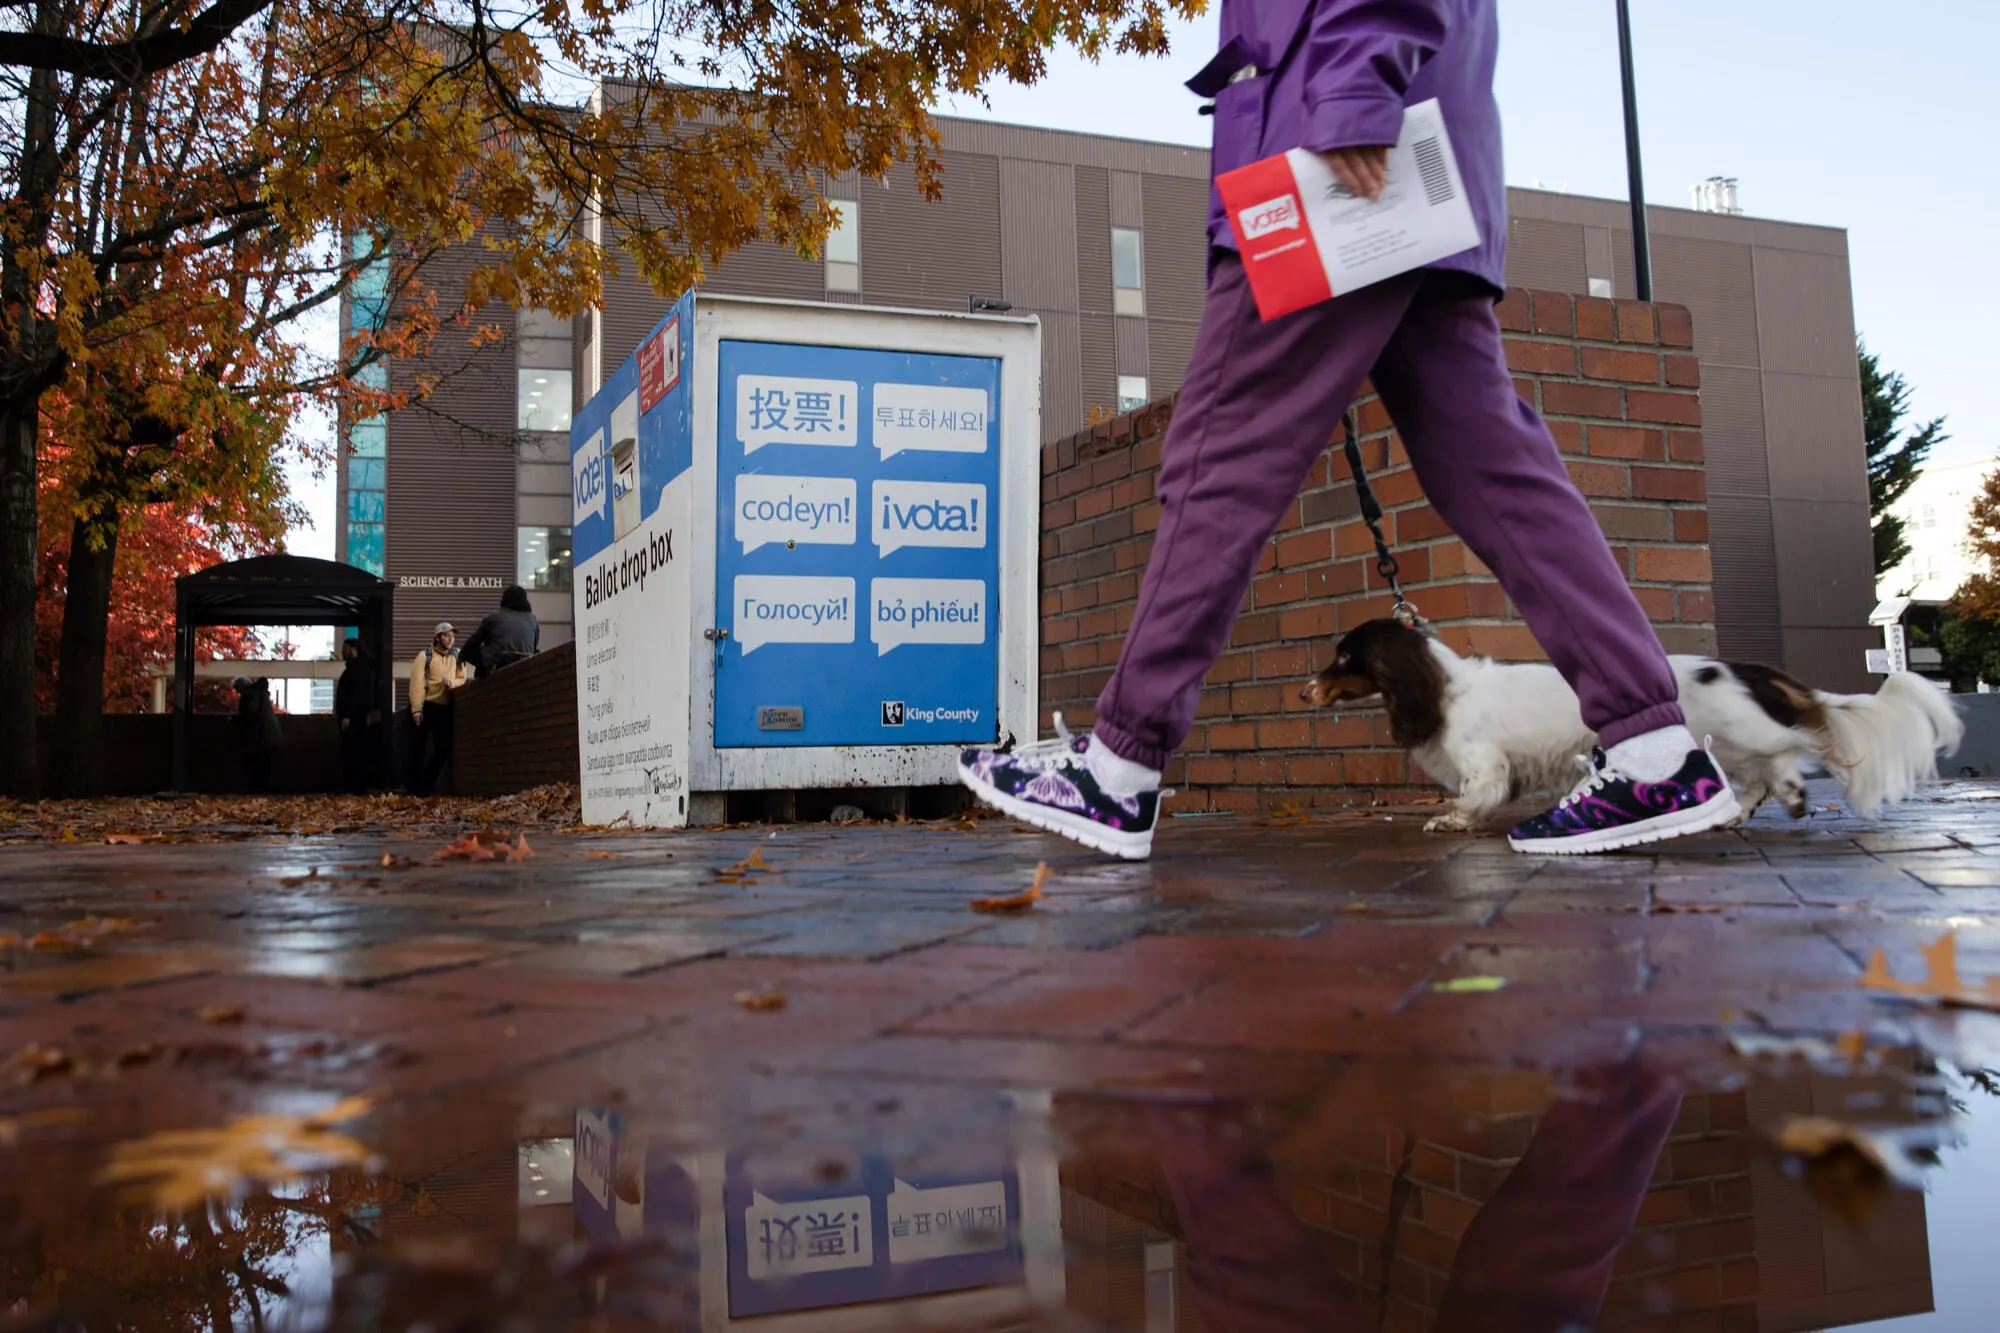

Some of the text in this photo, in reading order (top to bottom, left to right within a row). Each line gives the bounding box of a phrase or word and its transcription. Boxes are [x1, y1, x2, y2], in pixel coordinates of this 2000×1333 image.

[749, 387, 846, 433] 投票!
[876, 407, 983, 432] 투표하세요!
[575, 440, 604, 509] vote!
[742, 495, 850, 529] codeyn!
[882, 495, 978, 532] ¡vota!
[400, 575, 503, 588] SCIENCE & MATH
[586, 528, 673, 610] Ballot drop box
[743, 598, 848, 626] Голосуй!
[878, 599, 979, 628] bỏ phiếu!
[906, 708, 979, 722] King County
